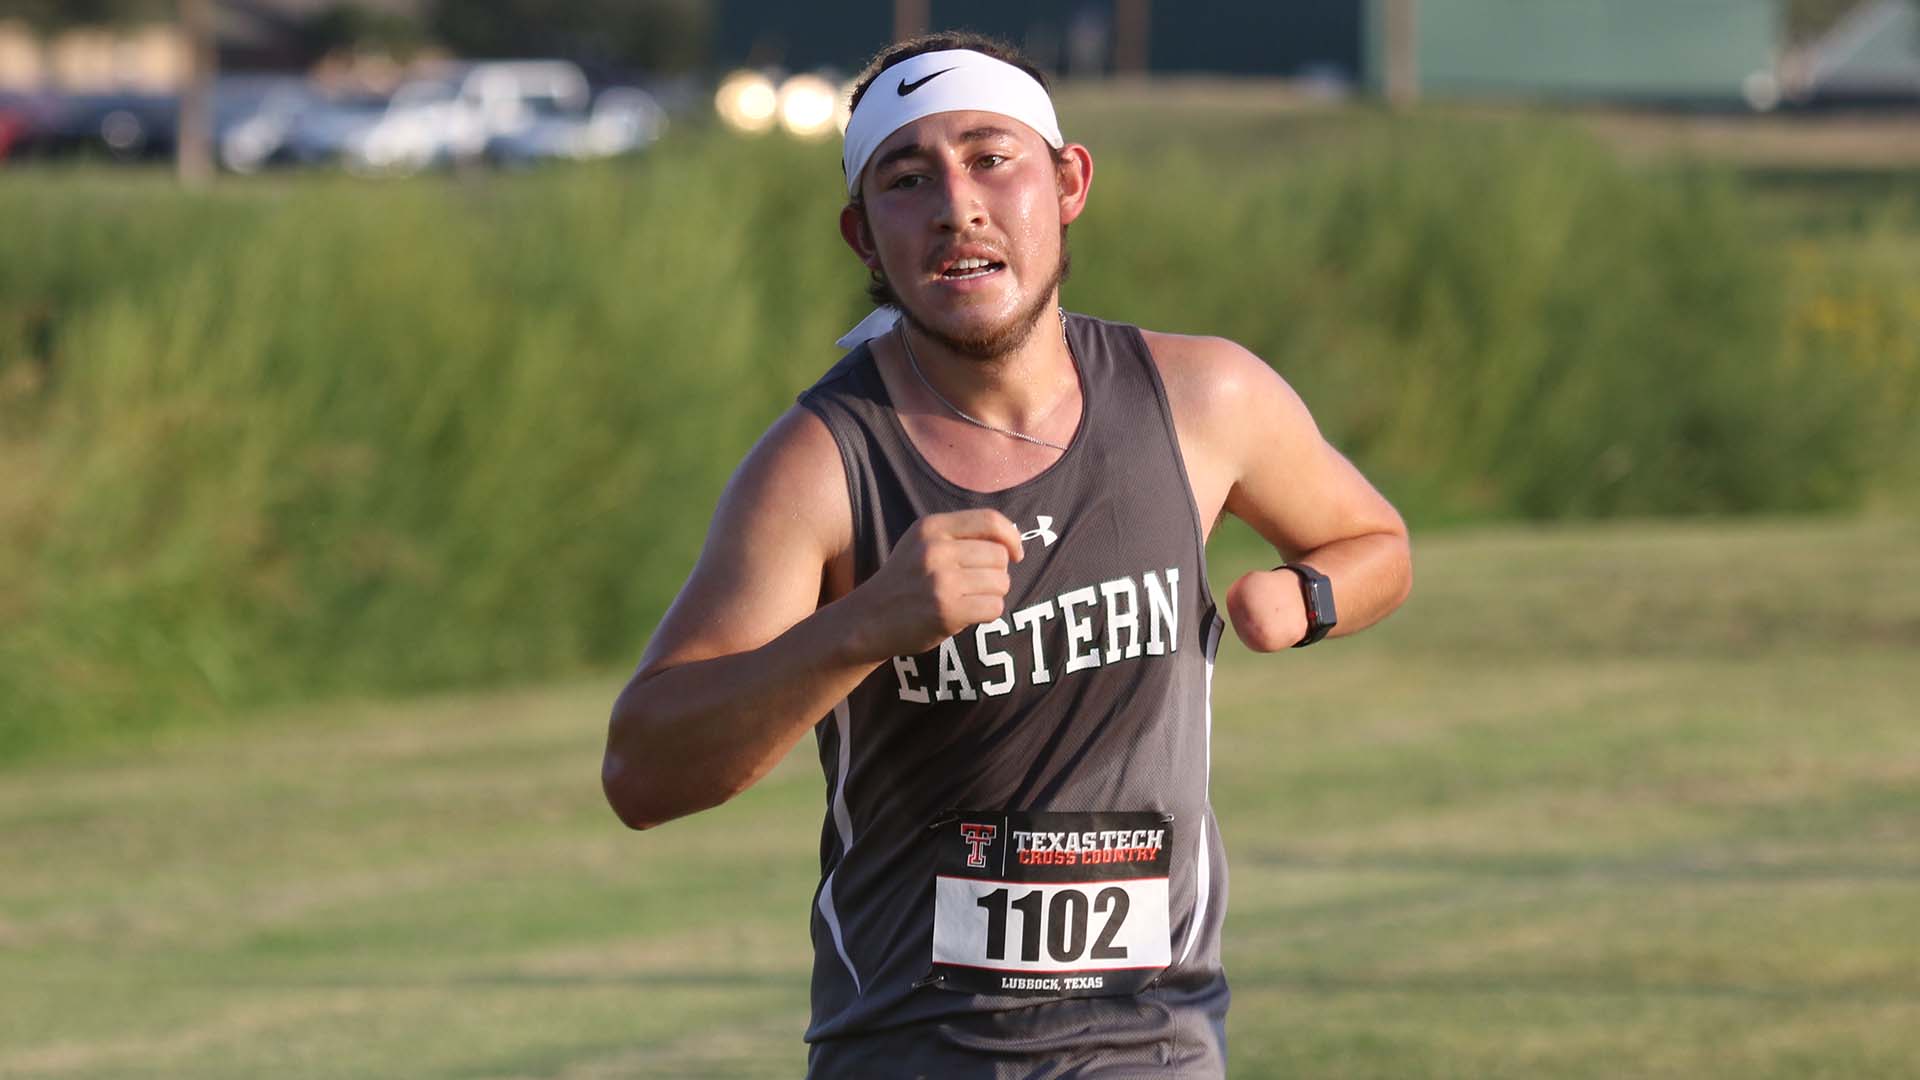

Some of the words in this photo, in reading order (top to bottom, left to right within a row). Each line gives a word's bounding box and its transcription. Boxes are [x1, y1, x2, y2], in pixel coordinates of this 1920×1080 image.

[893, 567, 1180, 704] EASTERN
[1012, 830, 1097, 854] TEXAS
[1100, 829, 1165, 851] TECH
[1018, 849, 1077, 865] CROSS
[1081, 847, 1158, 865] COUNTRY
[976, 886, 1131, 963] 1102
[1001, 977, 1061, 991] LUBBOCK,
[1063, 977, 1103, 990] TEXAS
